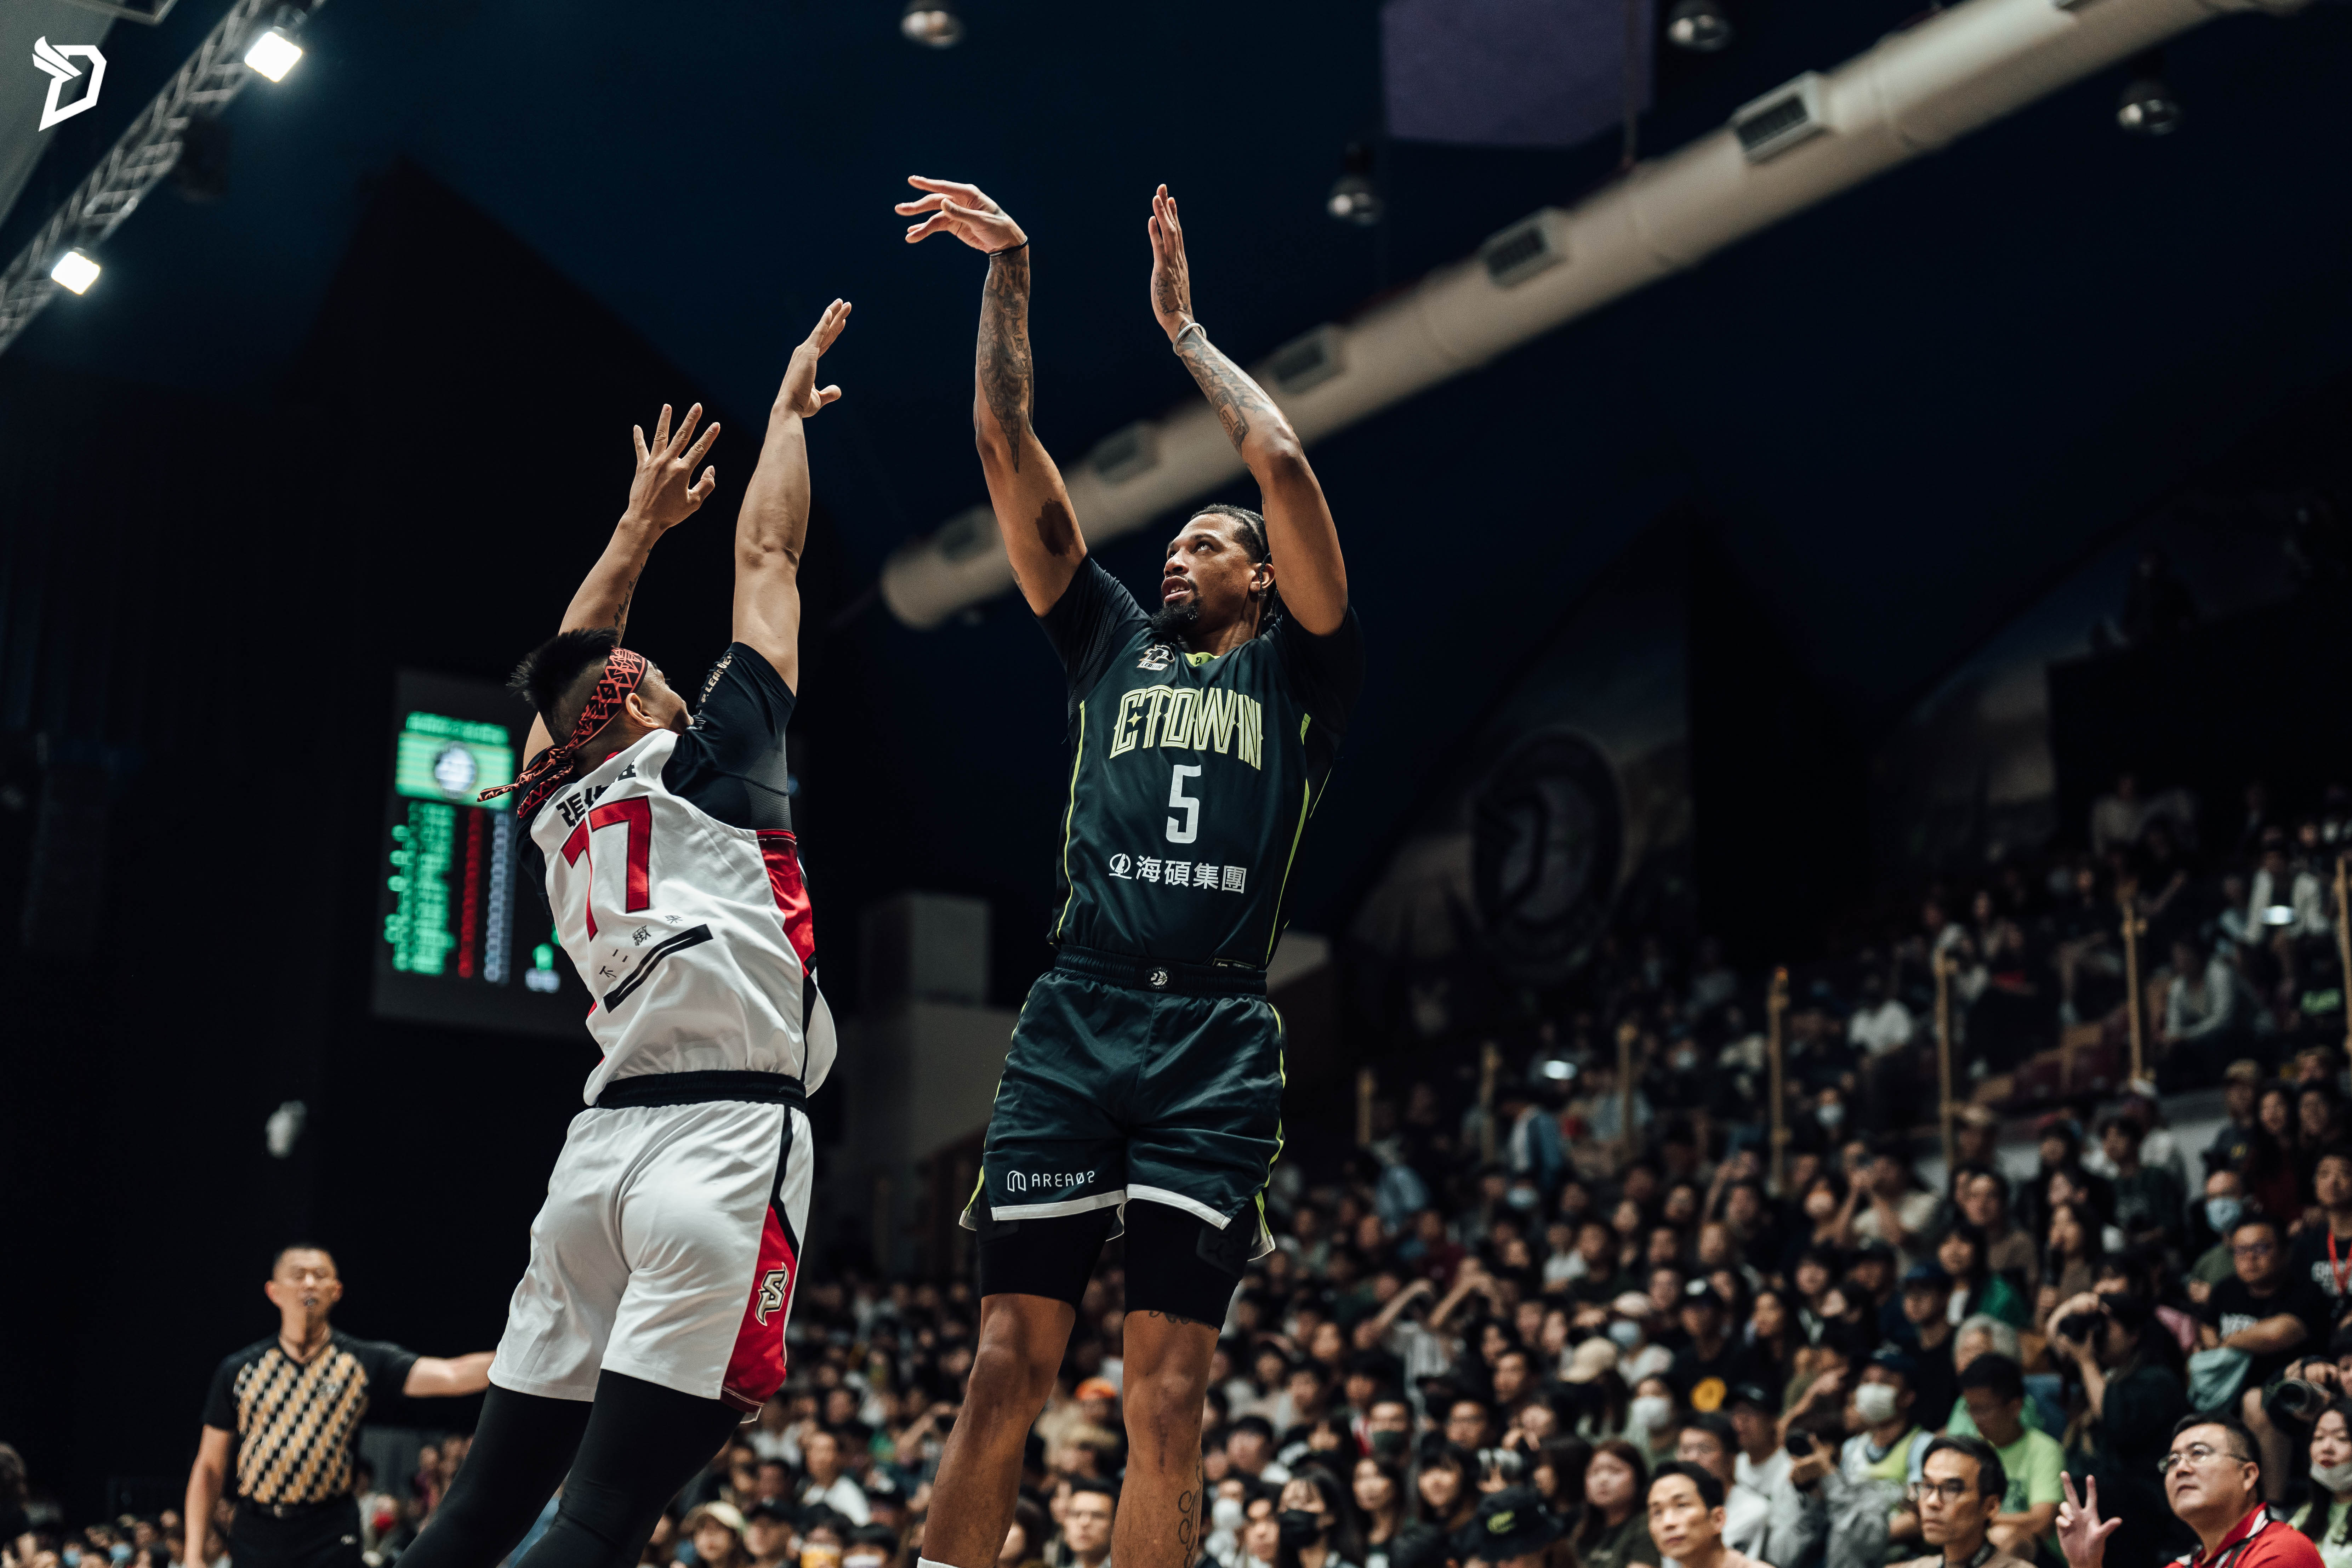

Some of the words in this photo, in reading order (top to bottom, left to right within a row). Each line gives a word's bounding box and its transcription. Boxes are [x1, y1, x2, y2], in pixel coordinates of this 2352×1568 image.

[1166, 764, 1201, 843] 5
[1136, 855, 1247, 894] 海碩集團
